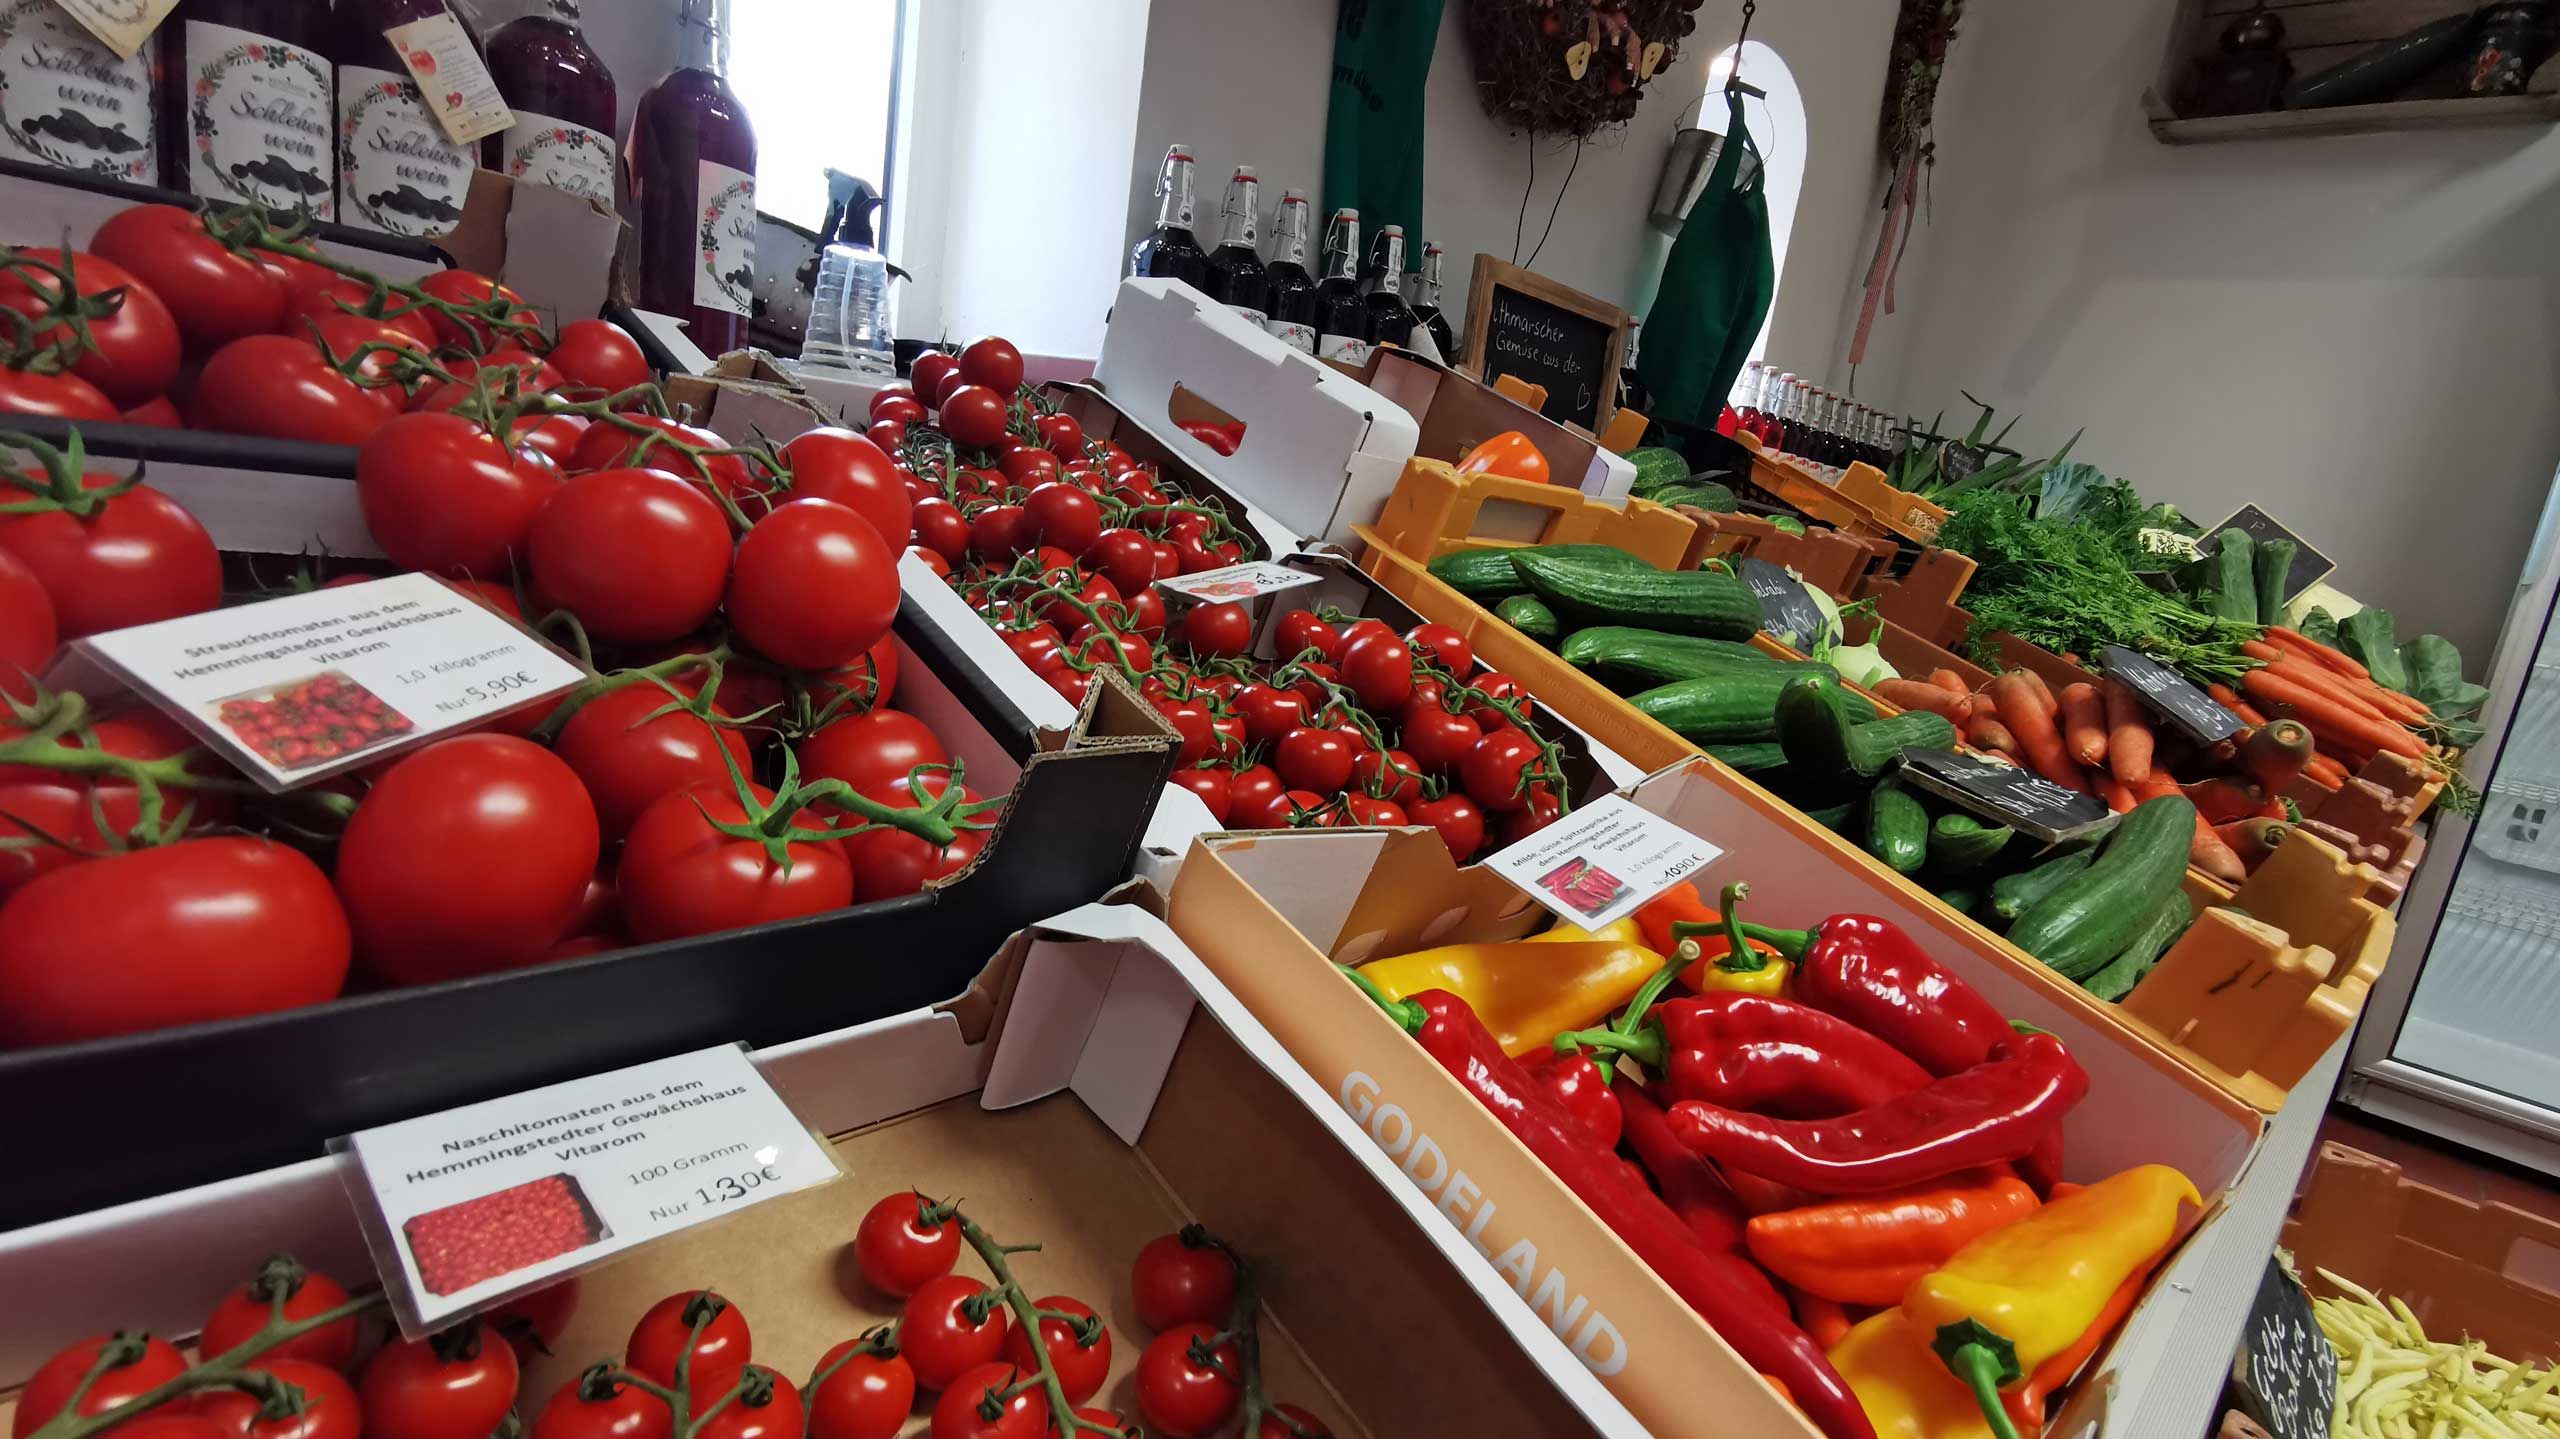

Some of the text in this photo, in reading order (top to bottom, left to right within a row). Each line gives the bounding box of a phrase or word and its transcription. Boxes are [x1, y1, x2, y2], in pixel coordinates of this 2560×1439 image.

[58, 84, 122, 112] wein
[230, 90, 326, 137] Schlehen
[264, 132, 316, 157] wein
[368, 126, 463, 168] Schlehen
[396, 165, 449, 187] wein
[1493, 300, 1565, 342] ithmarscher
[1496, 330, 1581, 374] Gemüse aus der
[174, 605, 464, 680] Hemmingstedter Gewächshaus
[184, 600, 421, 659] Strauchtomaten aus dem
[311, 639, 391, 666] Vitarom
[396, 644, 518, 687] 1,0 Kilogramm
[436, 696, 470, 715] Nur
[1511, 852, 1541, 867] Milde,
[1607, 808, 1623, 817] aus
[1539, 820, 1620, 867] dem Hemmingstedter
[1613, 833, 1648, 852] Vitarom
[1640, 840, 1681, 866] Kilogramm
[406, 1084, 748, 1185] Hemmingstedter Gewächshaus
[441, 1077, 704, 1155] Naschitomaten aus dem
[555, 1131, 647, 1163] Vitarom
[628, 1140, 750, 1187] 100 Gramm
[649, 1199, 691, 1222] Nur
[1340, 1070, 1629, 1377] GODELAND
